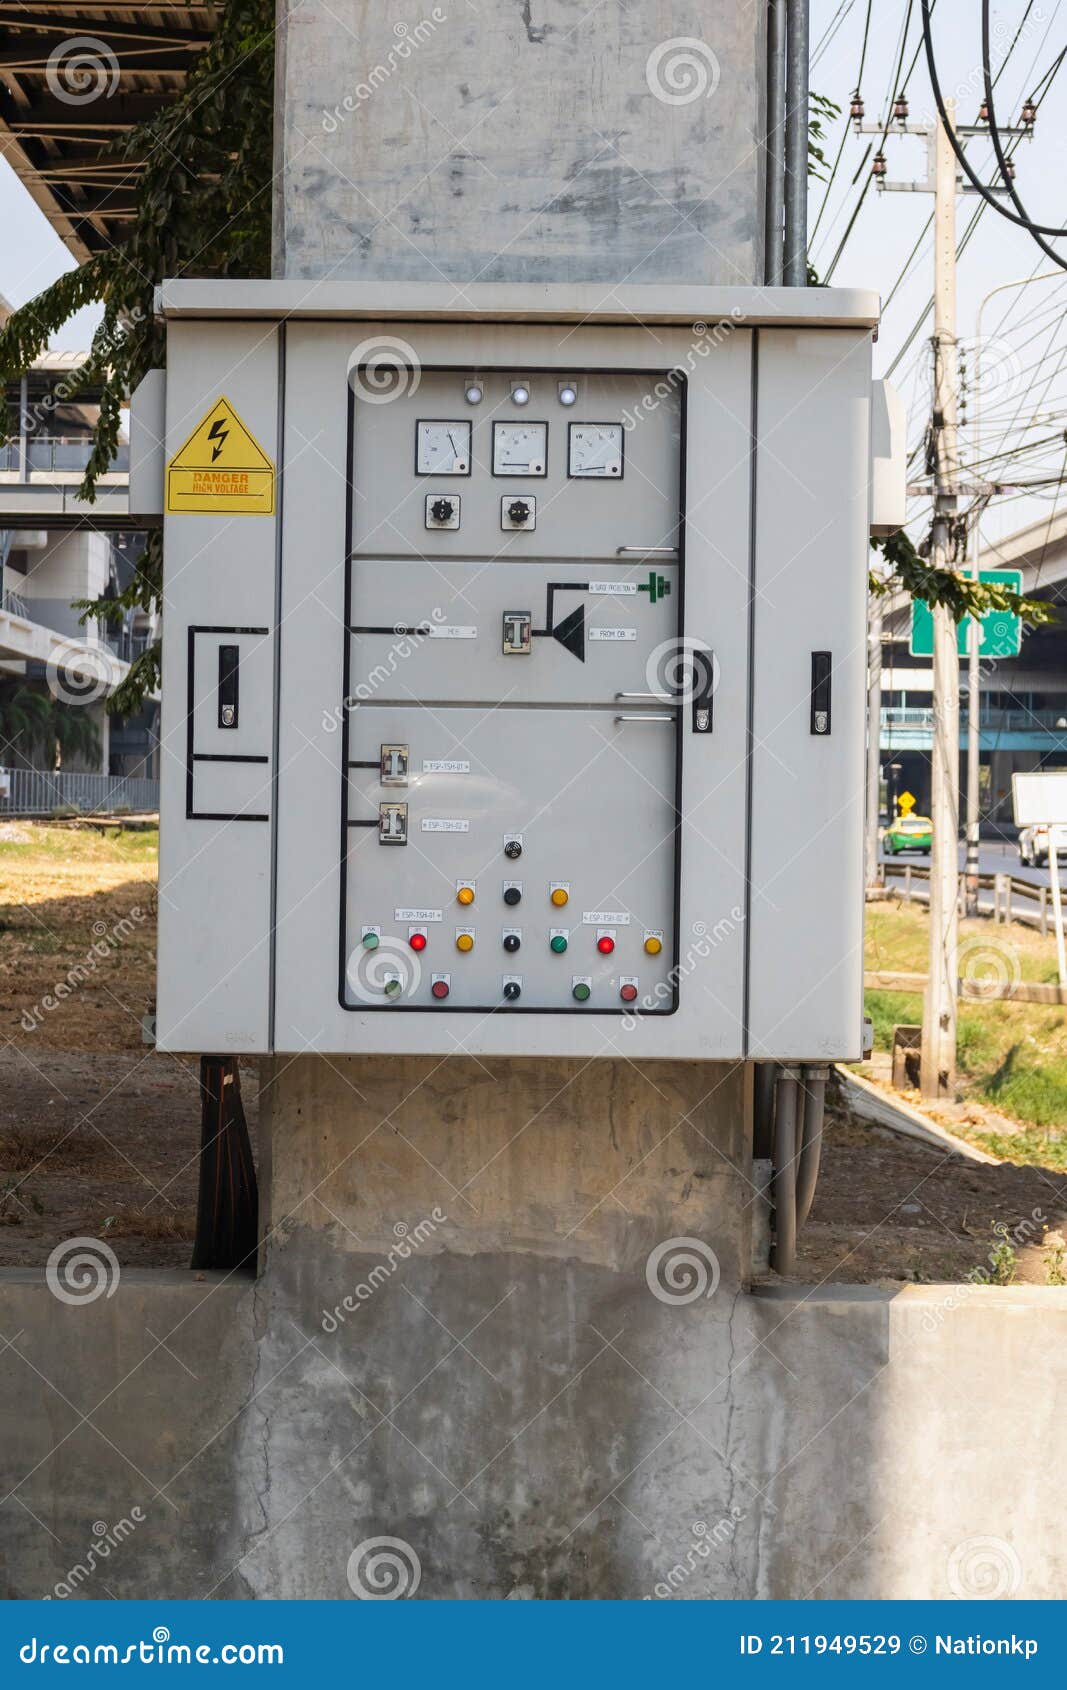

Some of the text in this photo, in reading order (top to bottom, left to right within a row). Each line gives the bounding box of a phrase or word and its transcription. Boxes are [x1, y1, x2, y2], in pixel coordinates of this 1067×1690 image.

[193, 472, 248, 483] DANGER
[192, 483, 249, 494] HIGH VOLTAGE
[600, 630, 615, 638] FROM
